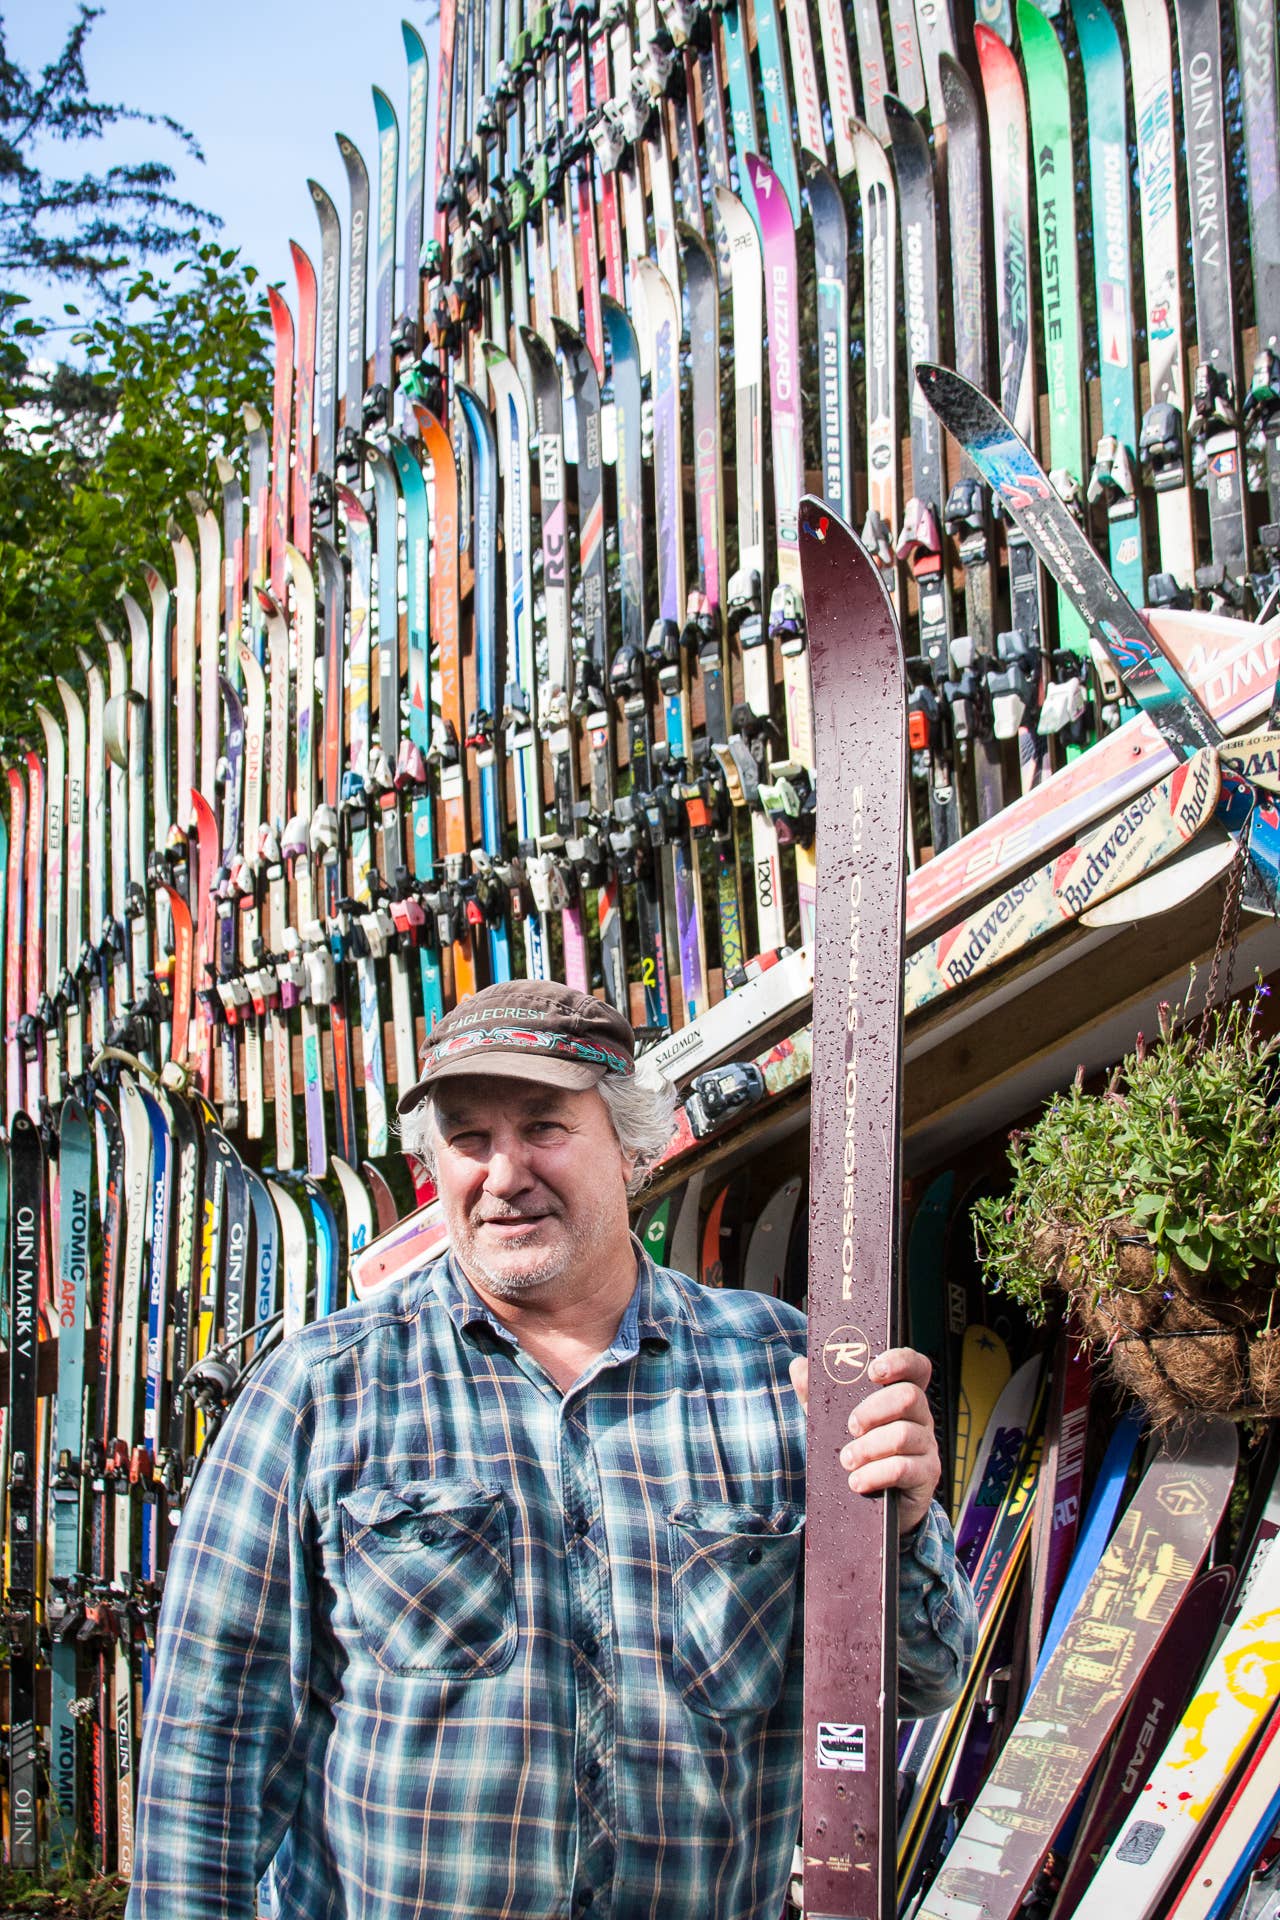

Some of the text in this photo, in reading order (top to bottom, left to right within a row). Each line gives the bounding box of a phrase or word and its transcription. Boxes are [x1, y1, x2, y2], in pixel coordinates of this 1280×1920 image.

[1189, 51, 1219, 268] OLIN MARK V
[351, 209, 364, 257] OLIN
[1105, 142, 1126, 281] ROSSIGNOL
[323, 256, 337, 305] OLIN
[350, 264, 364, 322] MARK
[907, 222, 928, 362] ROSSIGNOL
[321, 309, 336, 369] MARK
[773, 265, 793, 401] BLIZZARD
[438, 515, 453, 577] OLIN
[441, 586, 457, 665] MARK
[758, 858, 773, 908] 1200
[1063, 793, 1156, 914] Budweiser
[847, 874, 862, 1032] STRATO
[947, 874, 1038, 985] Budweiser
[446, 1008, 548, 1033] EAGLECREST
[655, 1031, 702, 1065] SALOMON
[131, 1172, 144, 1226] OLIN
[841, 1051, 856, 1301] ROSSIGNOL
[71, 1189, 87, 1282] ATOMIC
[127, 1234, 140, 1298] MARK
[151, 1173, 165, 1305] ROSSIGNOL
[228, 1222, 243, 1283] OLIN
[15, 1207, 34, 1359] OLIN MARK V
[60, 1279, 76, 1329] ARC
[59, 1724, 75, 1818] ATOMIC
[119, 1719, 130, 1768] OLIN
[1122, 1697, 1165, 1794] HEAD
[15, 1789, 32, 1847] OLIN
[119, 1780, 131, 1841] COMP
